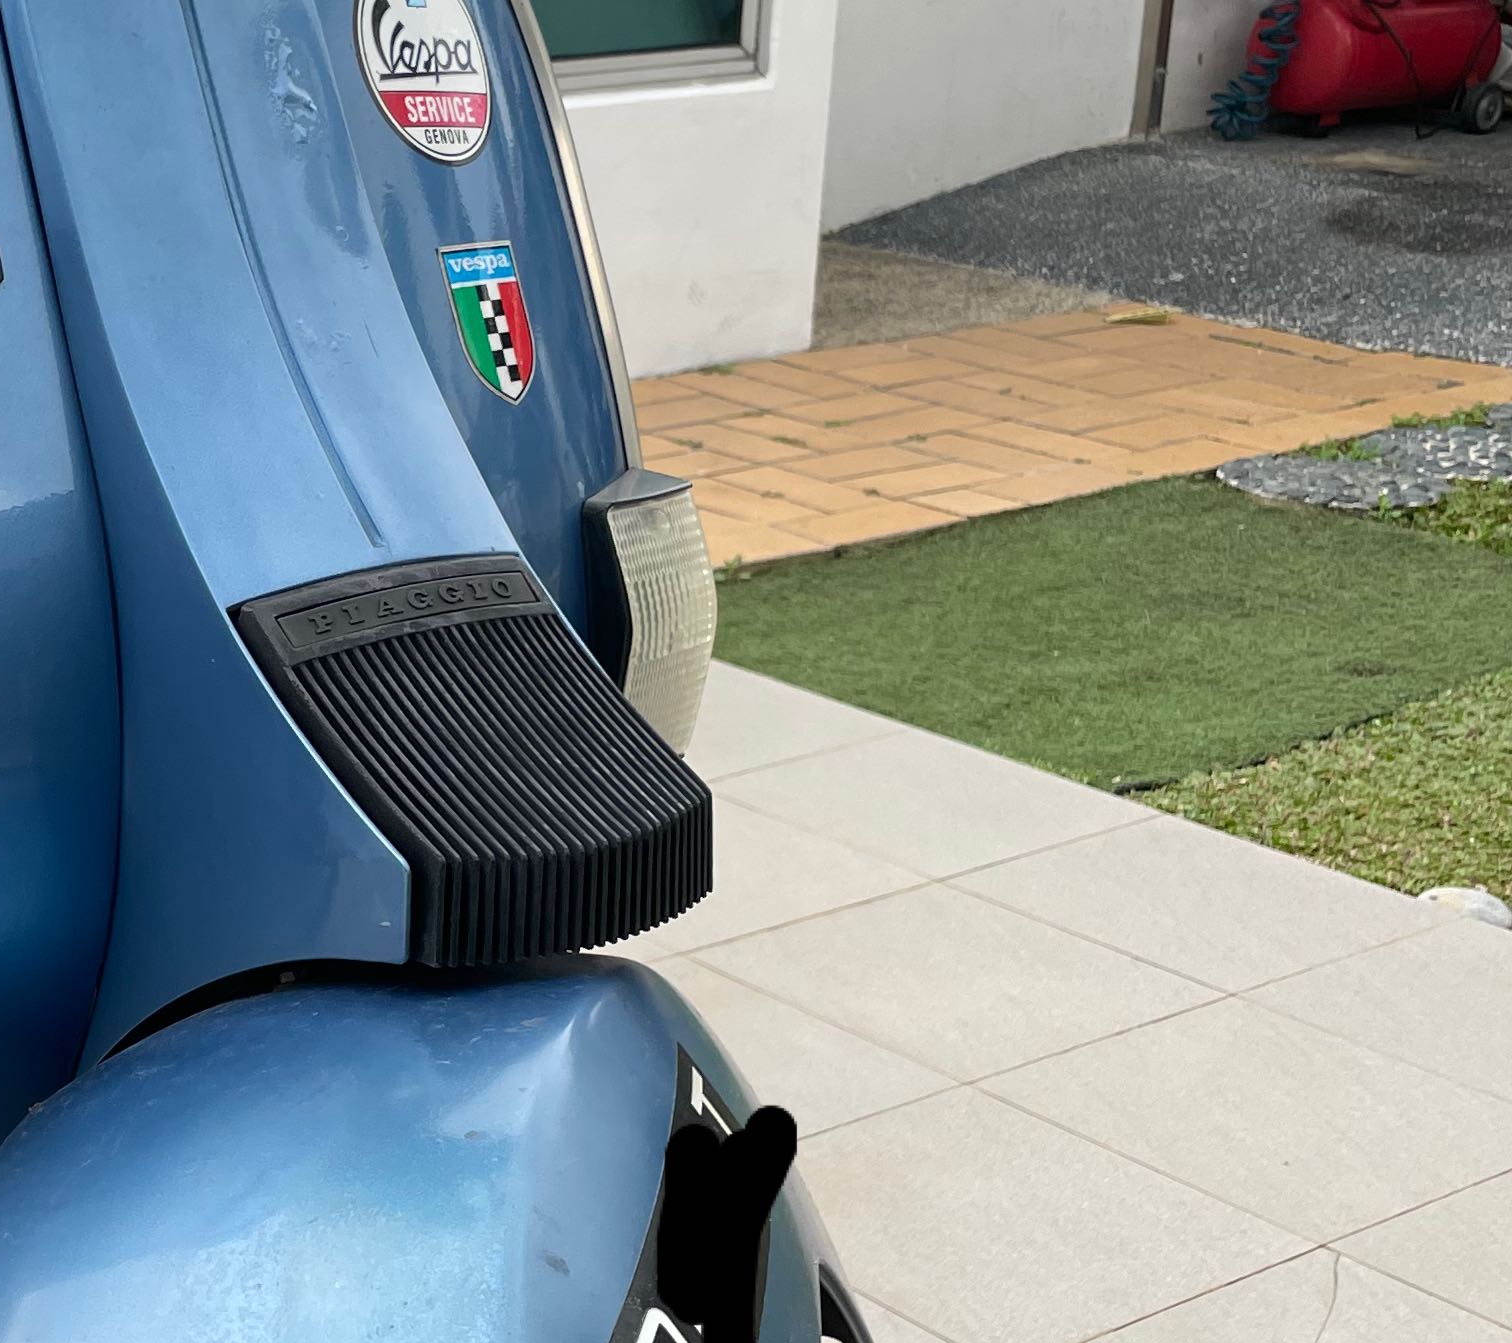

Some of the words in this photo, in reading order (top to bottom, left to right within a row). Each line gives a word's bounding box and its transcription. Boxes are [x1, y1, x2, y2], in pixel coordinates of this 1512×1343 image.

[404, 95, 476, 124] SERVICE
[424, 128, 470, 145] GENOVA
[448, 253, 510, 275] vespa
[308, 578, 513, 635] PIAGGIO
